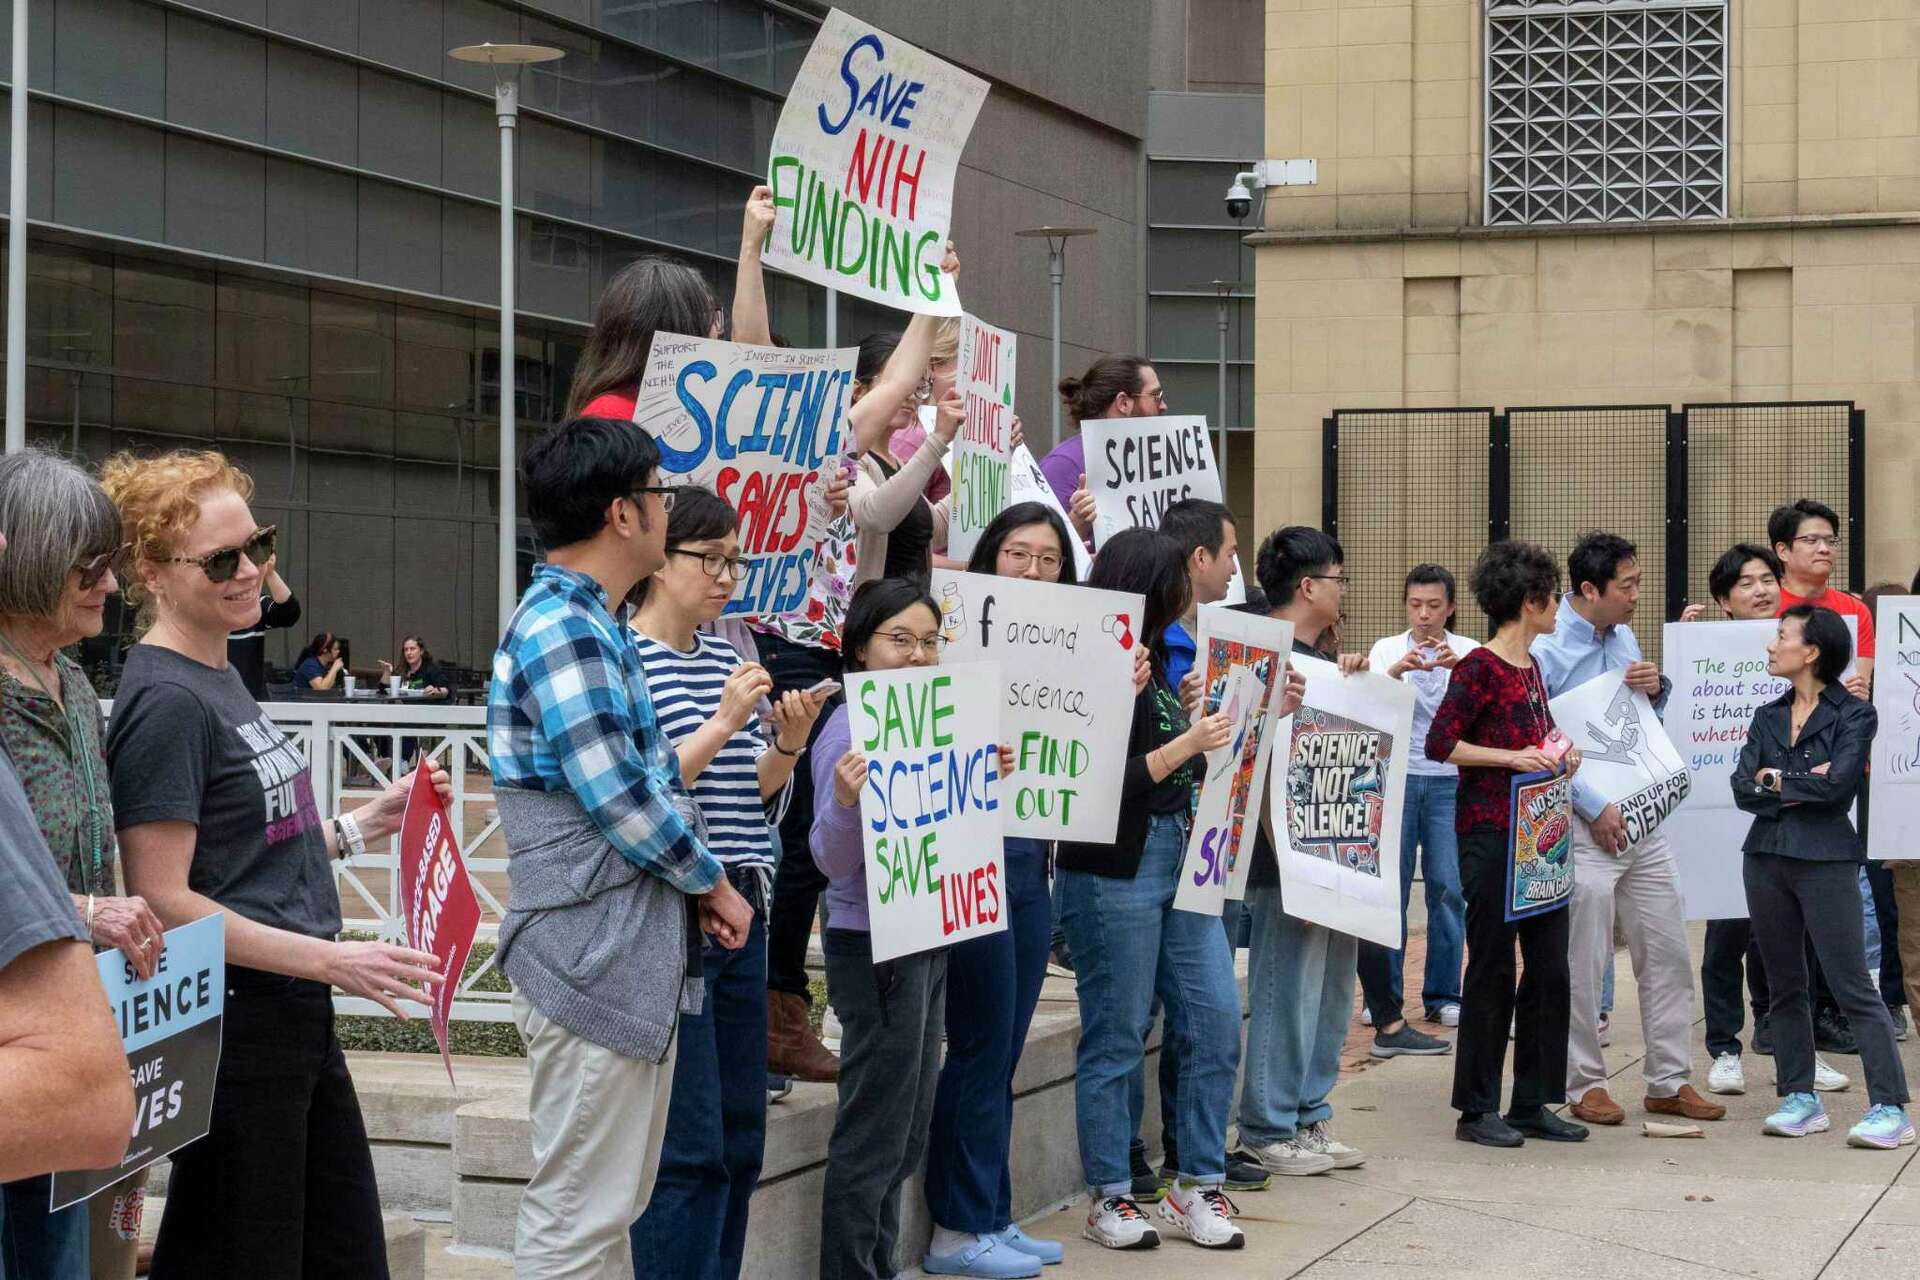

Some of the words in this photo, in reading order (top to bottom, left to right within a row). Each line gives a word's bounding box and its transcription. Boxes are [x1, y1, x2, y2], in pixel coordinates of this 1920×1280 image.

[818, 34, 925, 135] SAVE
[845, 128, 926, 221] NIH
[764, 156, 941, 301] FUNDING
[653, 342, 701, 357] SUPPORT
[656, 360, 675, 371] THE
[745, 350, 781, 362] INVEST
[784, 352, 795, 365] IN
[972, 325, 1001, 393] DON'T
[655, 360, 853, 473] SCIENCE
[962, 389, 1005, 453] SILENCE
[1105, 425, 1207, 489] SCIENCE
[961, 451, 1007, 533] SCIENCE
[1007, 621, 1079, 654] around
[1692, 658, 1726, 675] The
[1692, 680, 1745, 697] about
[860, 676, 955, 752] SAVE
[1692, 704, 1705, 720] is
[1712, 703, 1753, 719] that
[1019, 731, 1089, 778] FIND
[1692, 725, 1749, 743] wheth
[1690, 753, 1724, 771] you
[868, 743, 998, 833] SCIENCE
[1016, 787, 1079, 825] OUT
[1311, 767, 1355, 804] NOT
[1616, 794, 1647, 815] AND
[1648, 784, 1664, 800] UP
[1666, 772, 1687, 791] FOR
[1293, 801, 1372, 839] SILENCE!
[1528, 794, 1546, 821] NO
[875, 832, 942, 905] SAVE
[1525, 880, 1555, 899] BRAIN
[940, 861, 999, 936] LIVES
[124, 947, 168, 985] SE
[112, 967, 210, 1039] IENCE
[132, 1080, 184, 1138] VES
